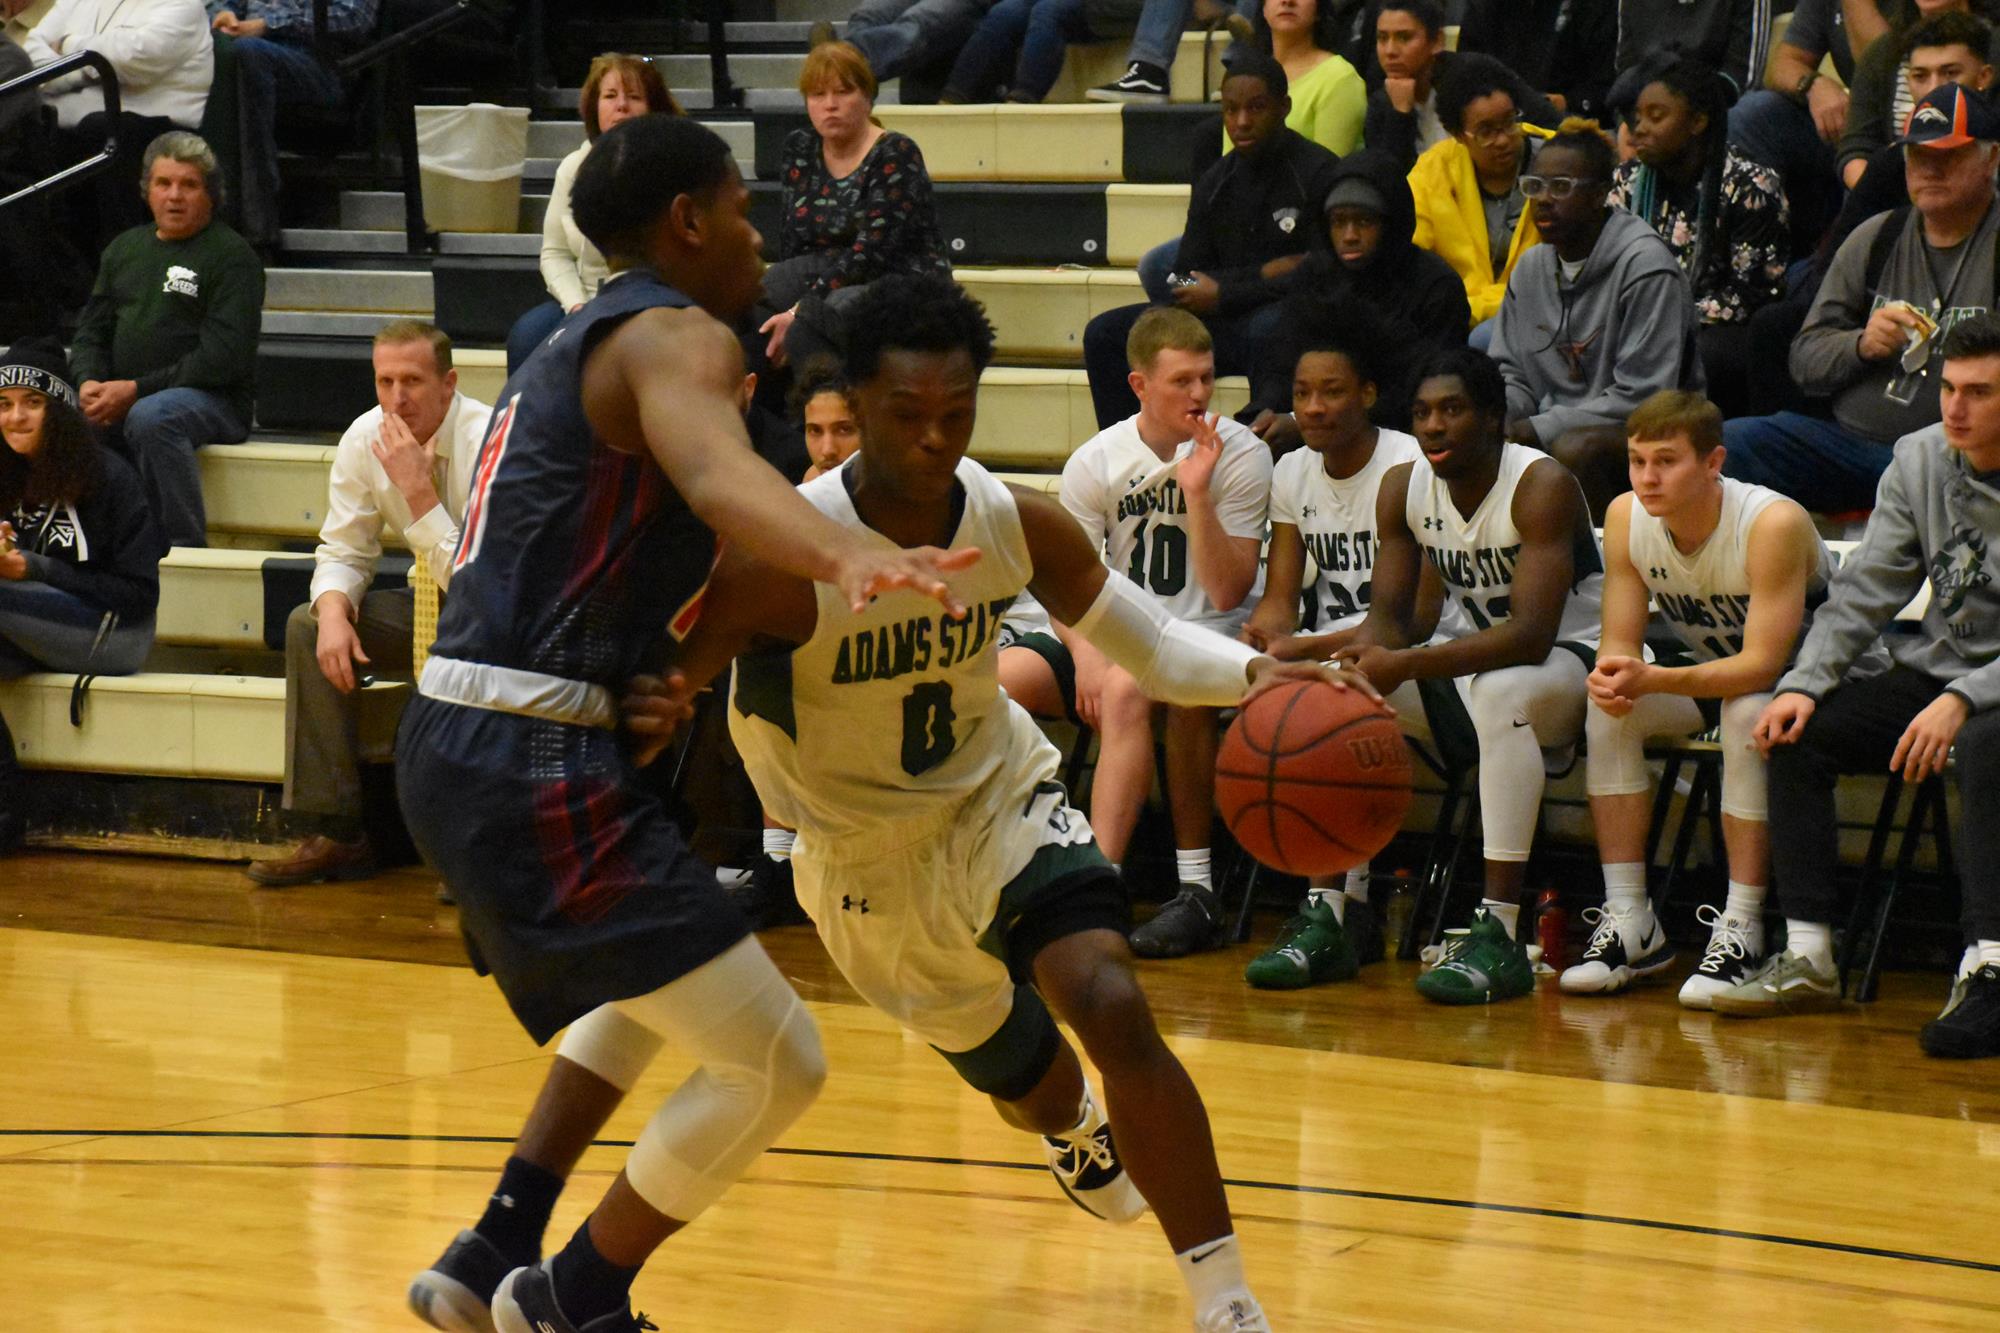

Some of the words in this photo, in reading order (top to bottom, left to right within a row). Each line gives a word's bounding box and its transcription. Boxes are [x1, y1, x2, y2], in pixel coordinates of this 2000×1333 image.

[1127, 518, 1187, 596] 10
[1305, 532, 1350, 571] DAMS
[1420, 542, 1477, 589] DAMS
[1476, 543, 1521, 588] STAT
[1709, 594, 1751, 629] STAT
[831, 616, 932, 685] ADAMS
[901, 679, 957, 777] 0
